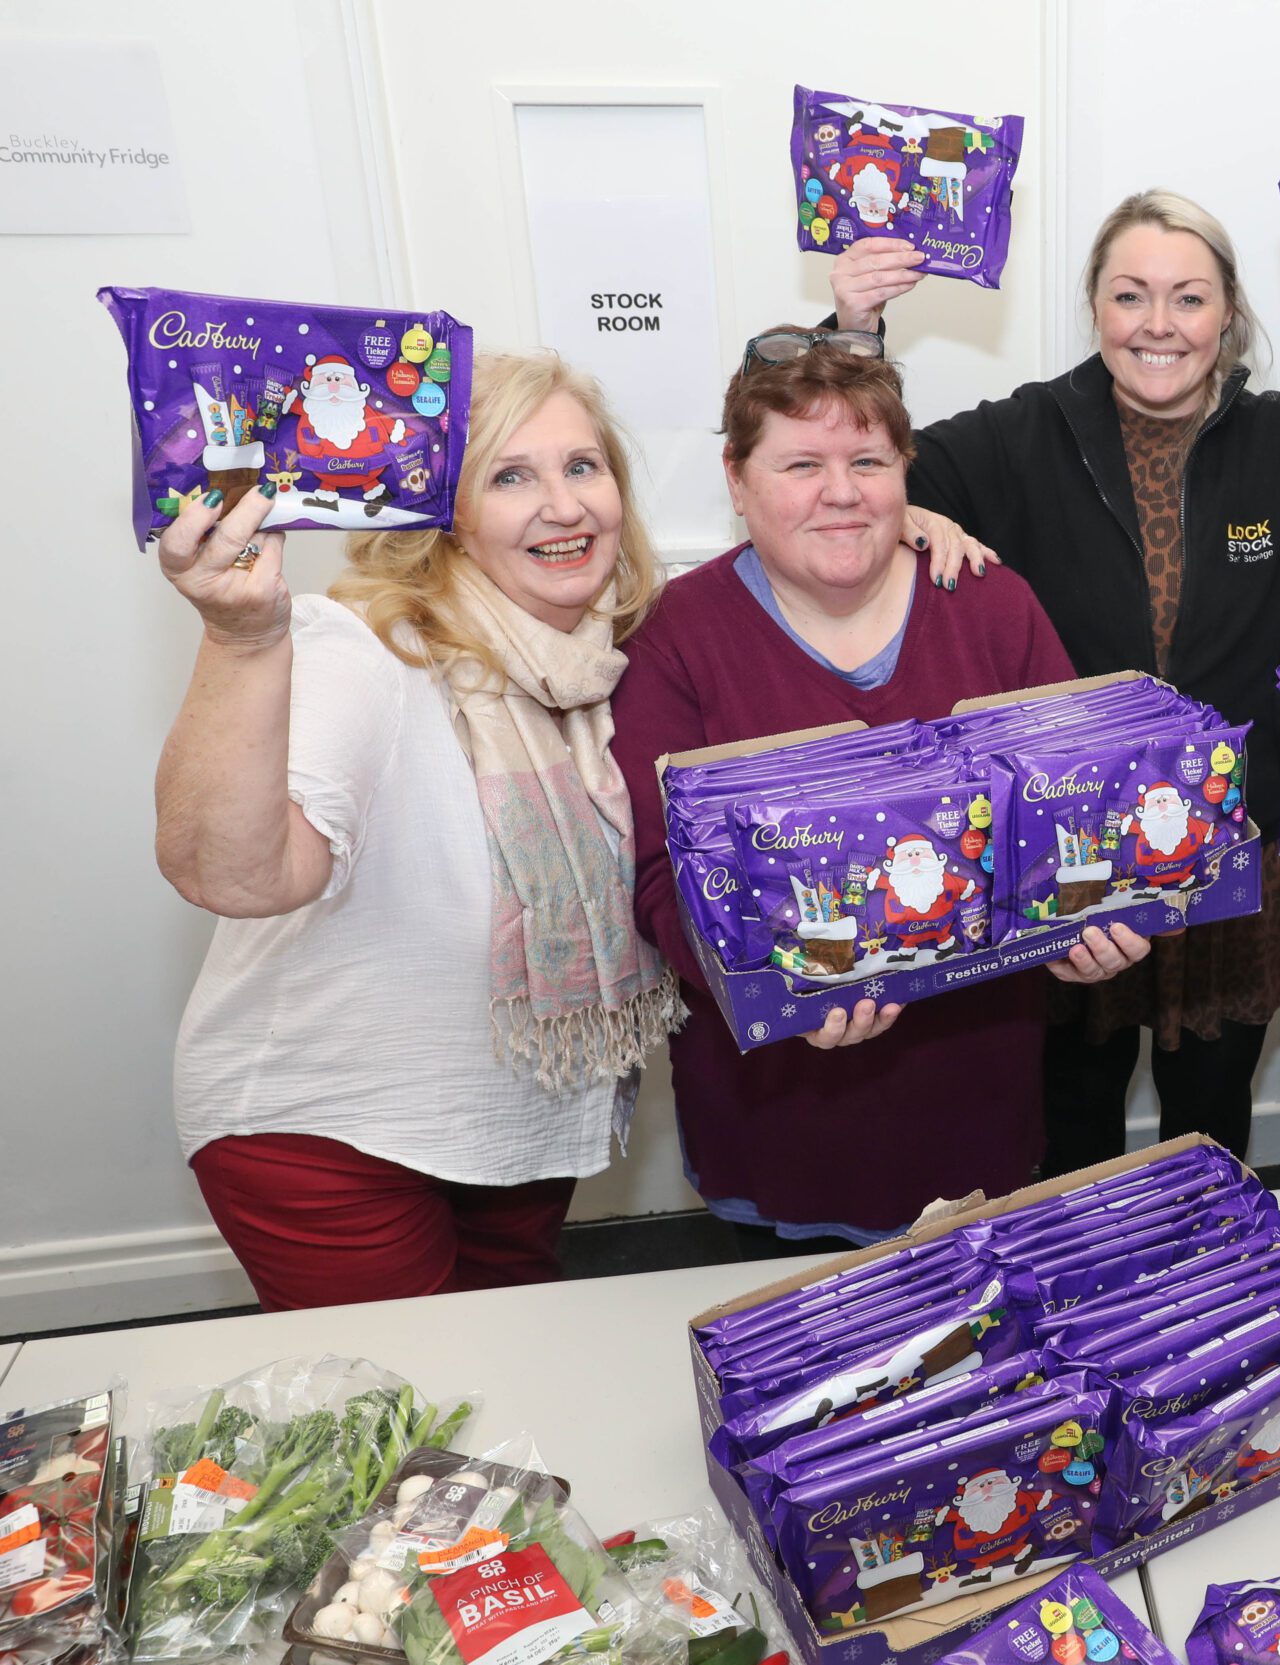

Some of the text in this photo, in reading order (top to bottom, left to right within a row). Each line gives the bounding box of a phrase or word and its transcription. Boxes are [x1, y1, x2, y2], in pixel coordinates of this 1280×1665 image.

[9, 134, 79, 151] Buckley
[0, 146, 169, 169] Community Fridge
[591, 293, 662, 309] STOCK
[597, 316, 660, 331] ROOM
[148, 310, 261, 360] Cadbury
[364, 335, 391, 347] FREE
[365, 346, 389, 356] Ticket
[327, 457, 365, 472] Cadbury
[1228, 519, 1271, 540] LOCK
[1228, 534, 1273, 553] STOCK
[1180, 758, 1203, 769] FREE
[1182, 768, 1203, 776] Ticket
[1023, 773, 1105, 802] Cadbury
[936, 810, 961, 821] FREE
[937, 820, 960, 829] Ticket
[752, 822, 844, 850] Cadbury
[1154, 862, 1182, 873] Cadbury
[908, 921, 939, 933] Cadbury
[945, 933, 1081, 982] Festive Favourites!
[1014, 1438, 1041, 1453] FREE
[1016, 1446, 1040, 1458] Ticket
[808, 1487, 912, 1532] Cadbury
[979, 1536, 1012, 1553] Cadbury
[1113, 1523, 1195, 1570] Favourites!
[456, 1572, 545, 1608] A PINCH OF
[458, 1584, 556, 1628] BASIL
[466, 1593, 558, 1634] GREAT WITH PASTA AND PIZZA
[1012, 1627, 1039, 1649] FREE
[1019, 1638, 1043, 1655] Ticket
